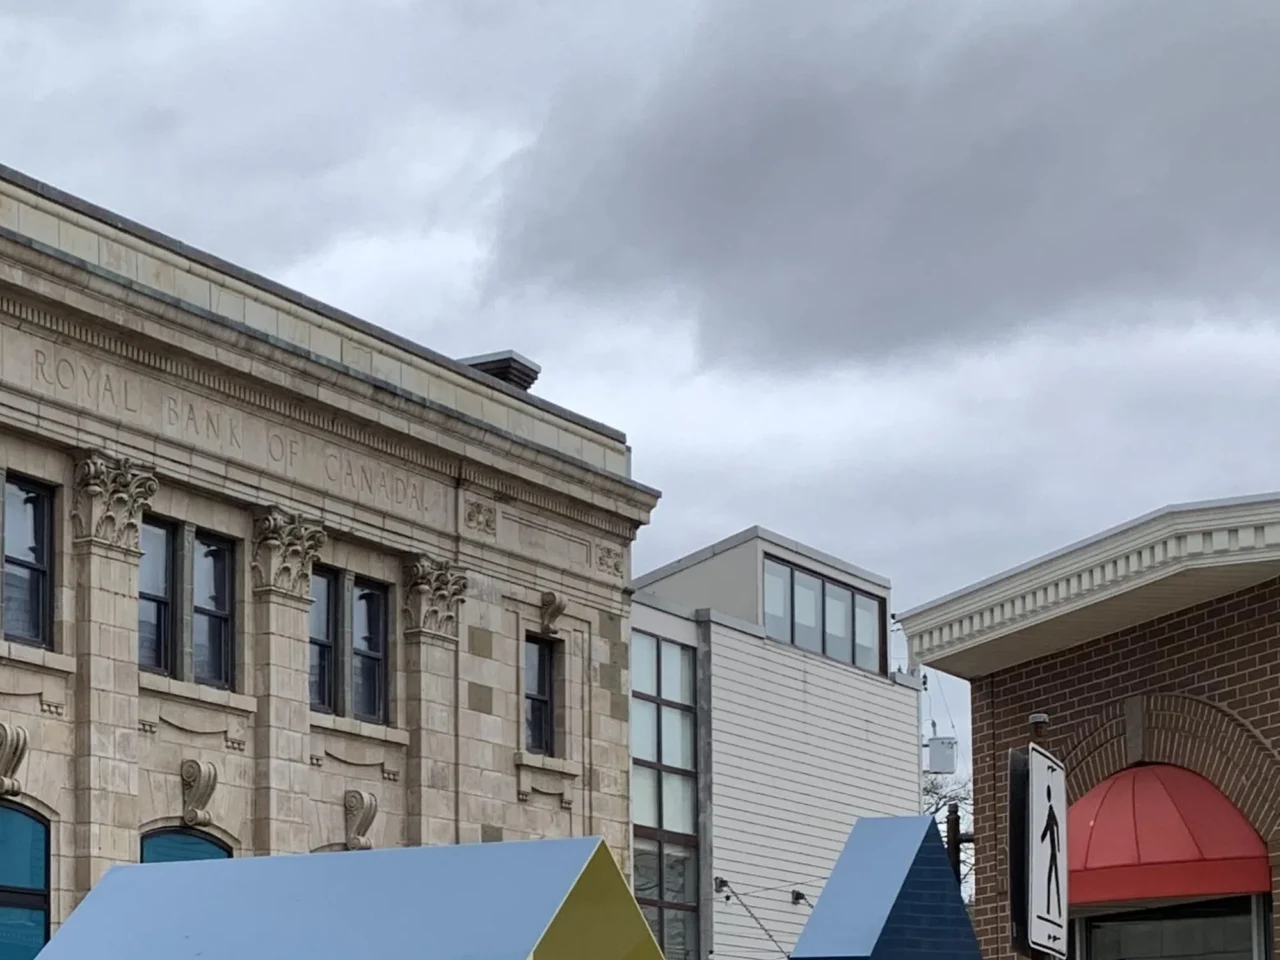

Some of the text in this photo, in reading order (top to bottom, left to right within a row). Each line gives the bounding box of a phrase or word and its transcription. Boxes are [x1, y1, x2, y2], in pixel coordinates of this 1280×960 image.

[34, 348, 137, 413] ROYAL
[167, 396, 242, 450] BANK
[269, 434, 300, 468] OF
